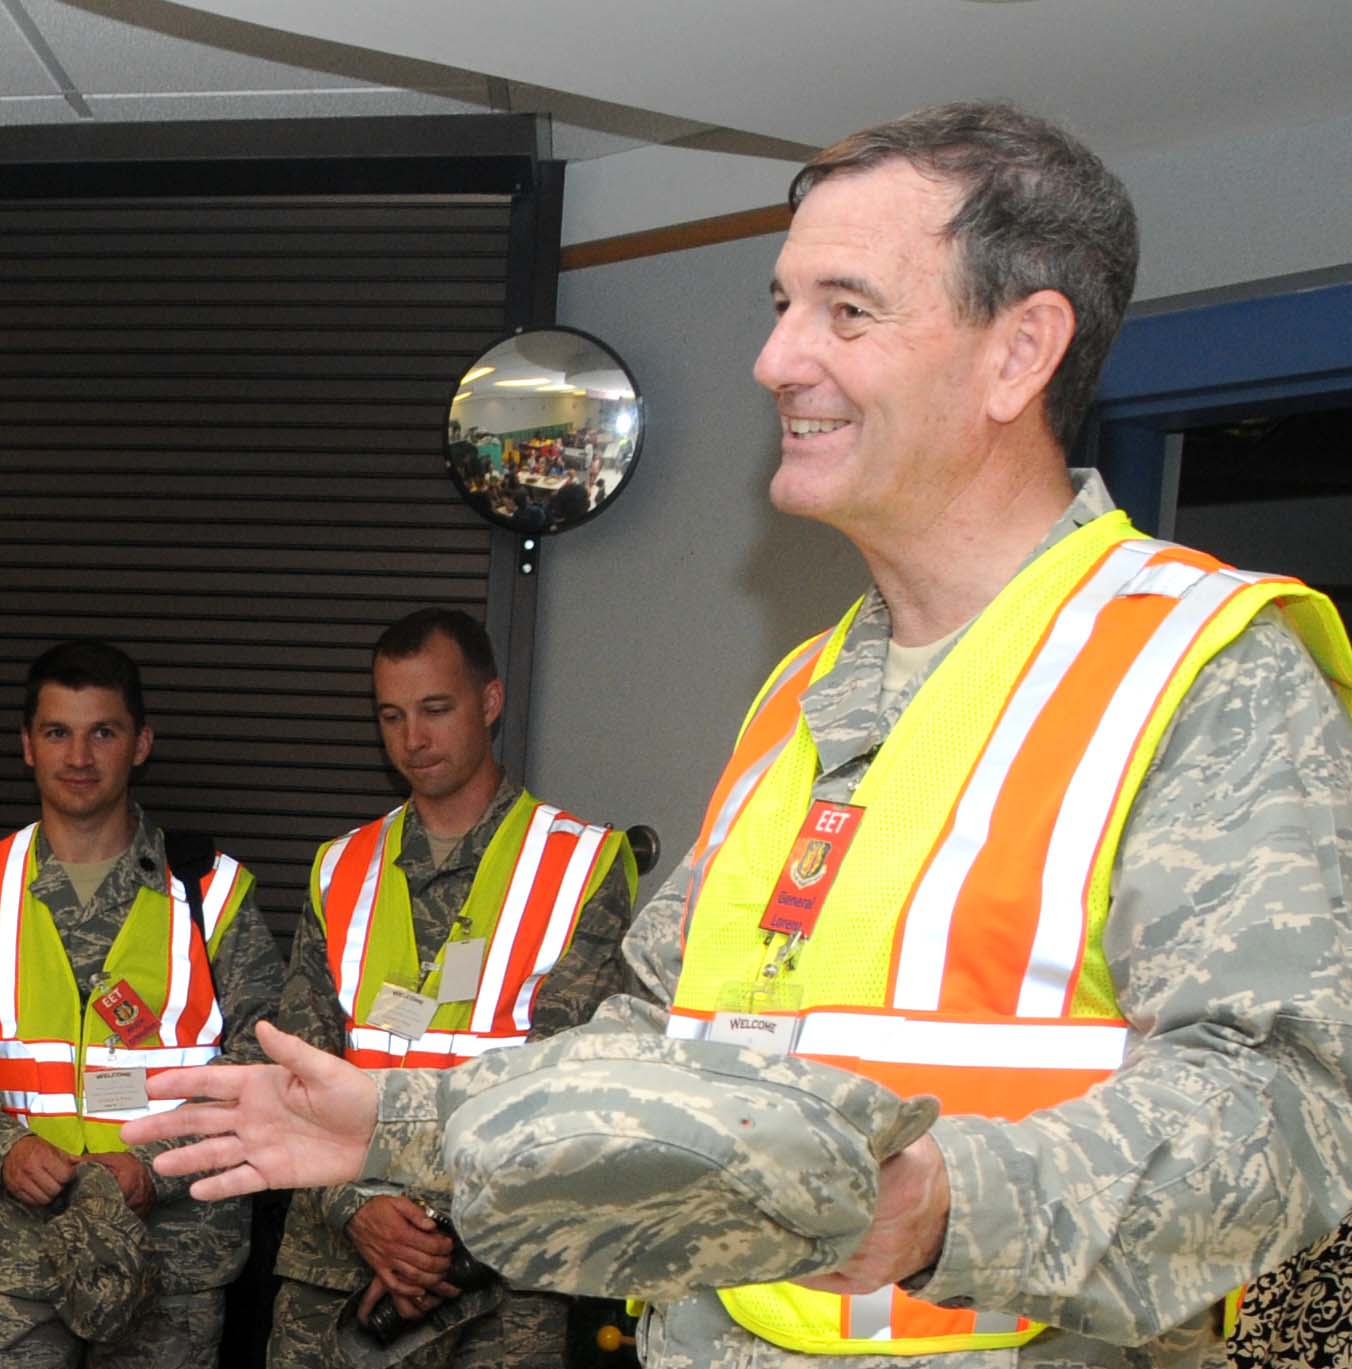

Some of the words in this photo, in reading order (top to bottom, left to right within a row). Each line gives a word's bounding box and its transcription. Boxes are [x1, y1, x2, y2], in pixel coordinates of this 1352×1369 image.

[815, 810, 851, 834] EET
[777, 891, 816, 910] General
[102, 987, 123, 1008] EET
[729, 1017, 777, 1034] WELCOME
